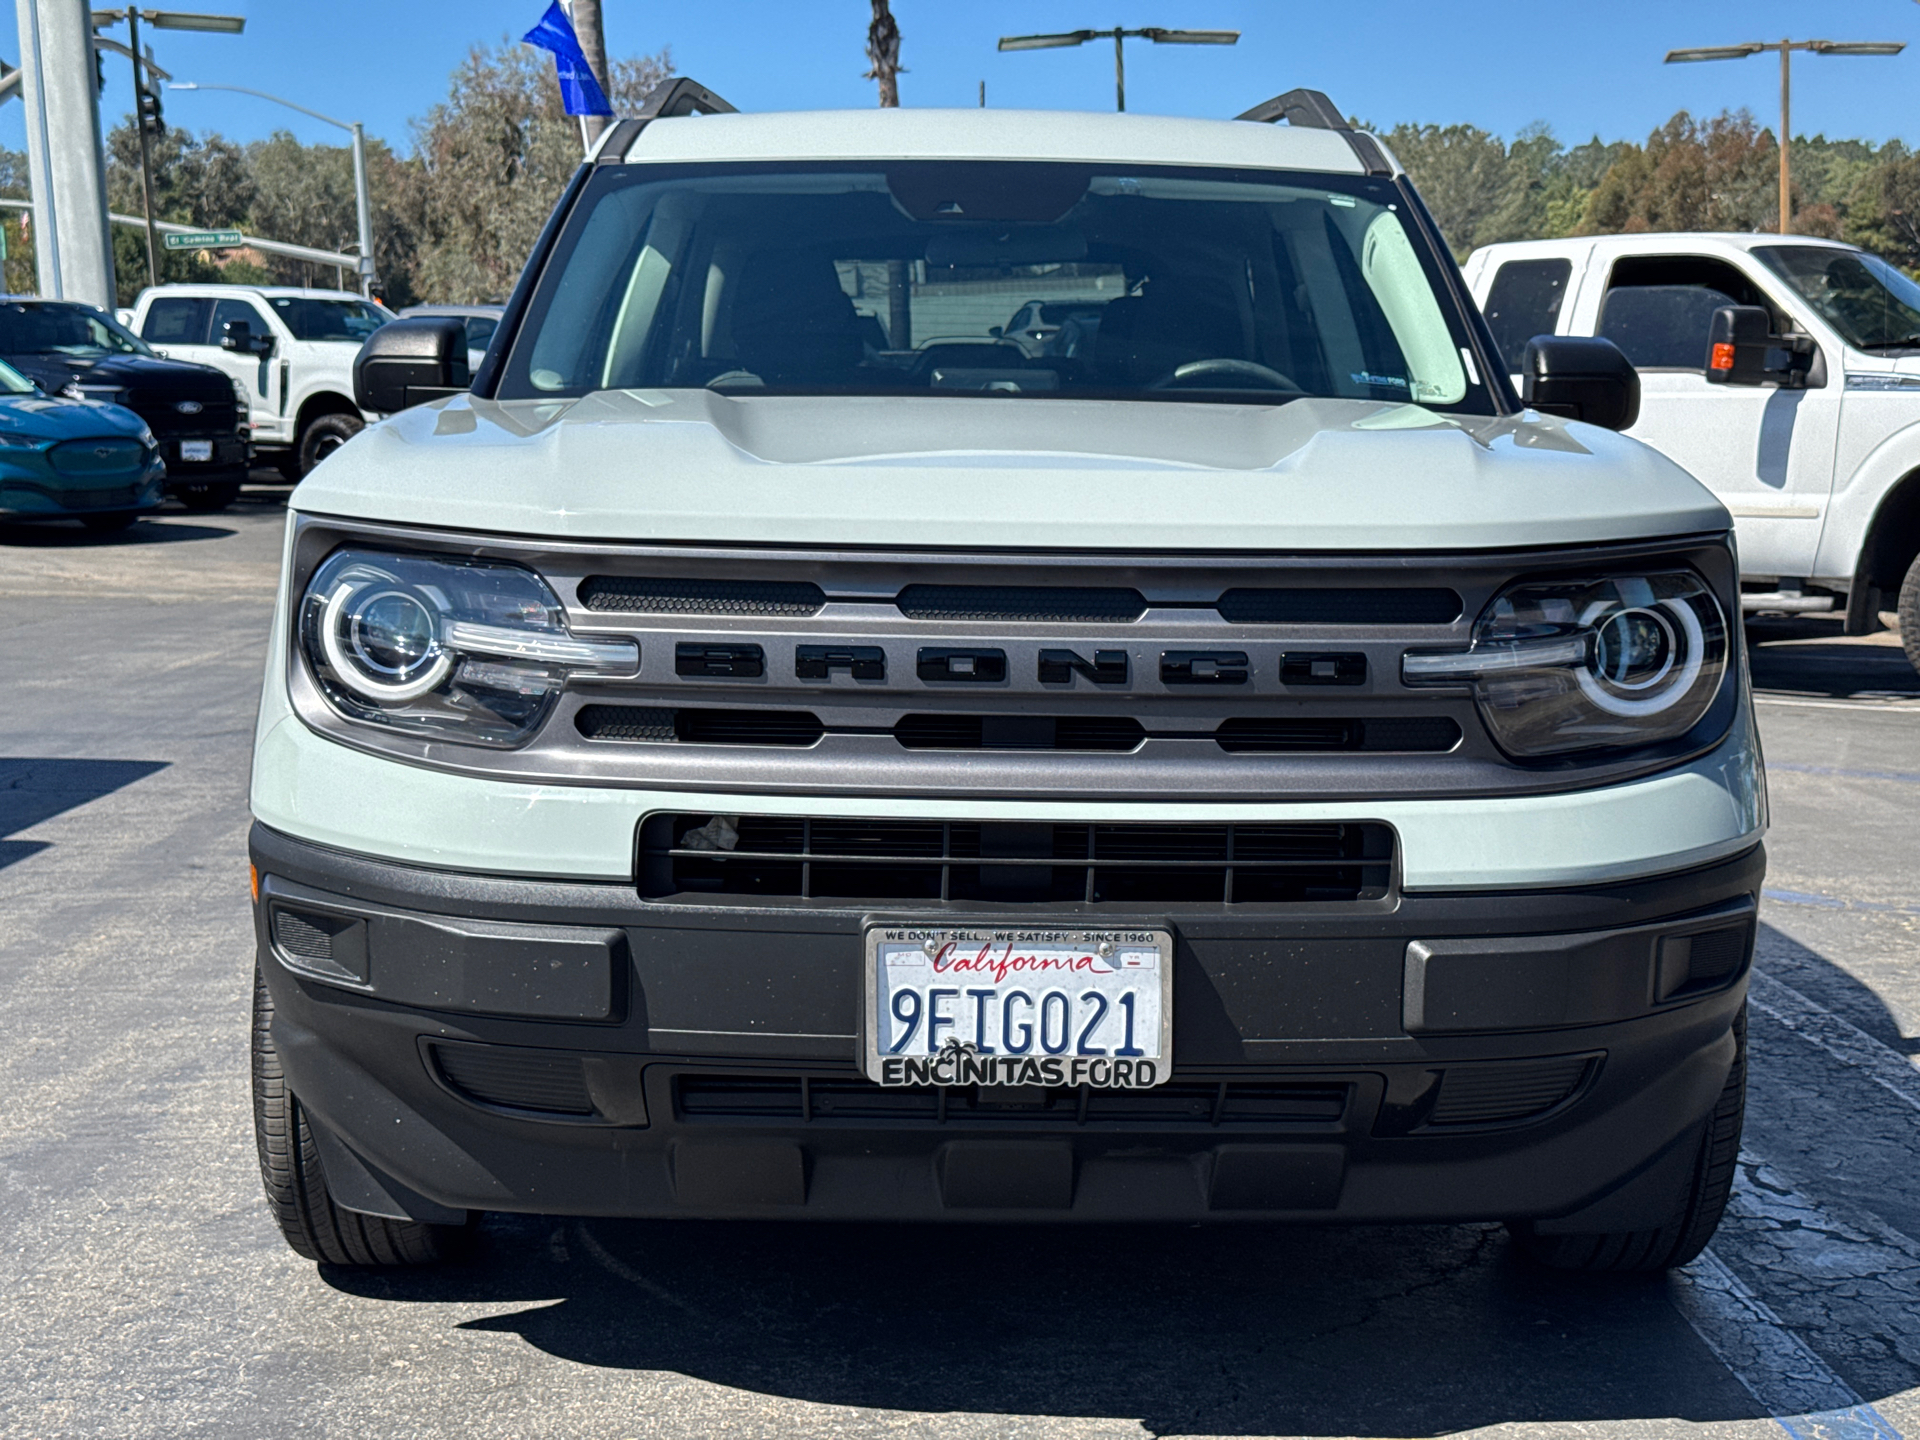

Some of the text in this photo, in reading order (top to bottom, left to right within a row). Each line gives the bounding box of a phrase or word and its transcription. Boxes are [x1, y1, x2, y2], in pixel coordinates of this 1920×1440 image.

[675, 641, 1367, 685] BRONCO
[885, 931, 1154, 943] WE DON'T SELL... WE SATISFY SINCE 1960
[933, 942, 1114, 983] California
[890, 988, 1144, 1056] 9EIG021
[882, 1048, 1156, 1087] ENCINITAS FORD
